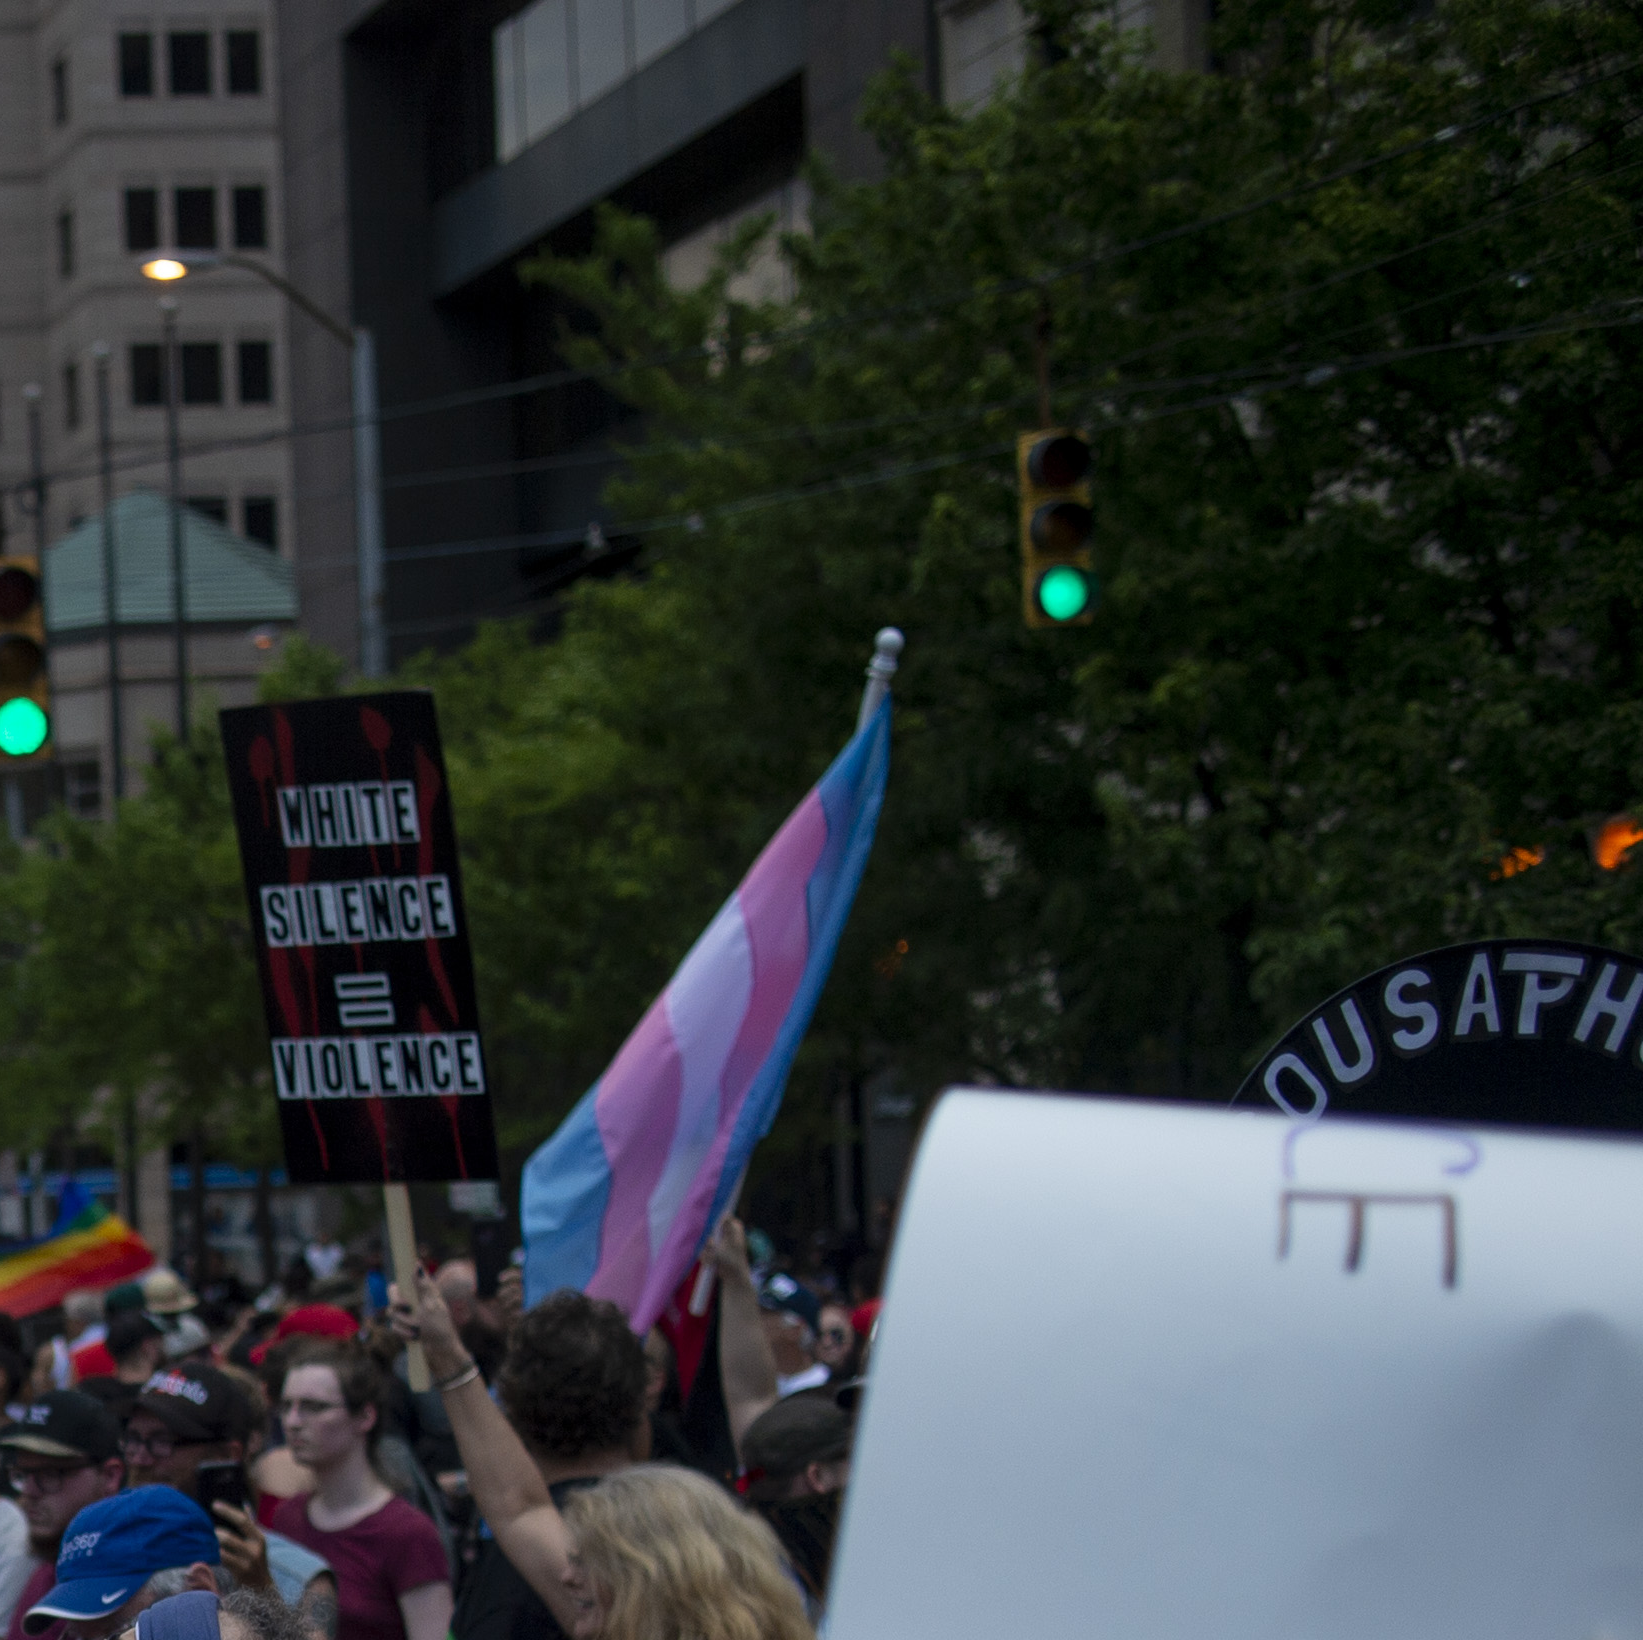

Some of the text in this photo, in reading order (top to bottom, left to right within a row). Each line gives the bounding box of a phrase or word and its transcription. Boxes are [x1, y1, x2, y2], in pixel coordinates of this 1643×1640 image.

[278, 781, 419, 847] WHITE
[261, 875, 456, 946] SILENCE
[272, 1032, 486, 1099] VIOLENCE
[1262, 951, 1643, 1122] OUSAPH
